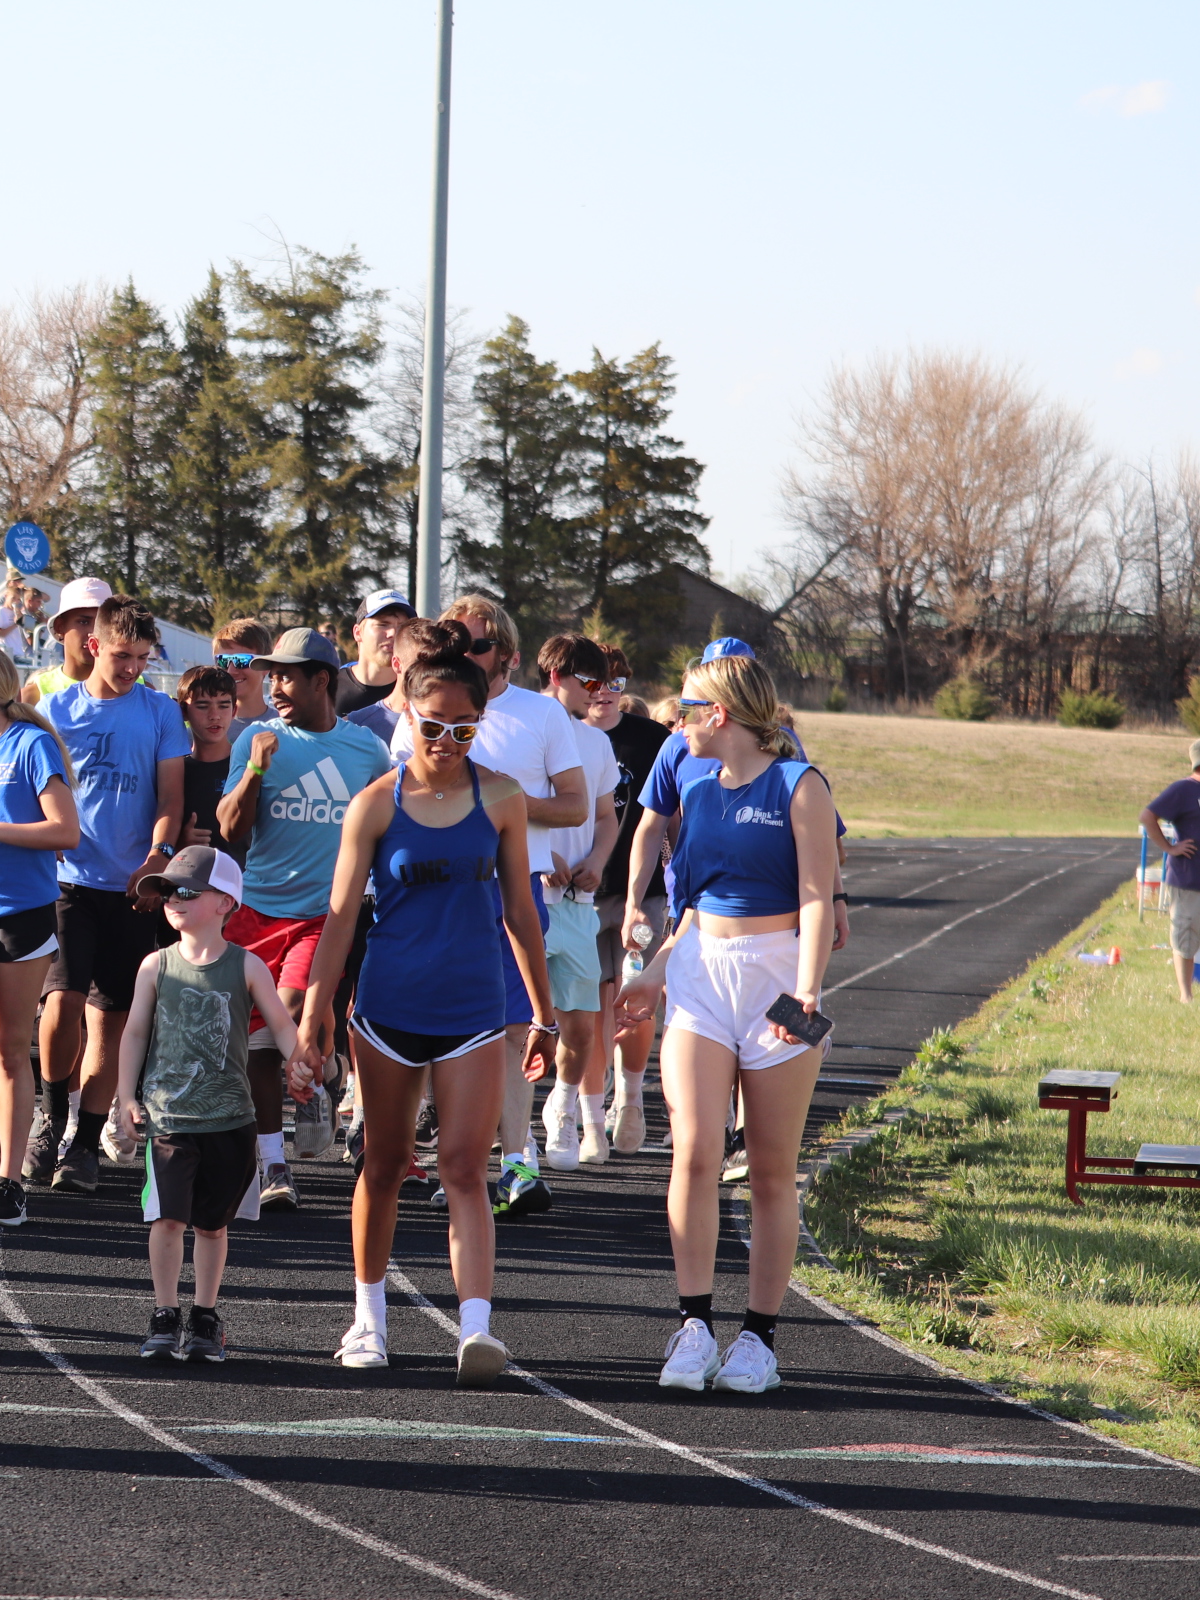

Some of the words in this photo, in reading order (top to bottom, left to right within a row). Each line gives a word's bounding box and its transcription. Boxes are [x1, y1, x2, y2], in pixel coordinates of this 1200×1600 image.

[17, 526, 34, 535] LHS
[17, 559, 42, 570] BAND
[753, 810, 773, 819] Bank
